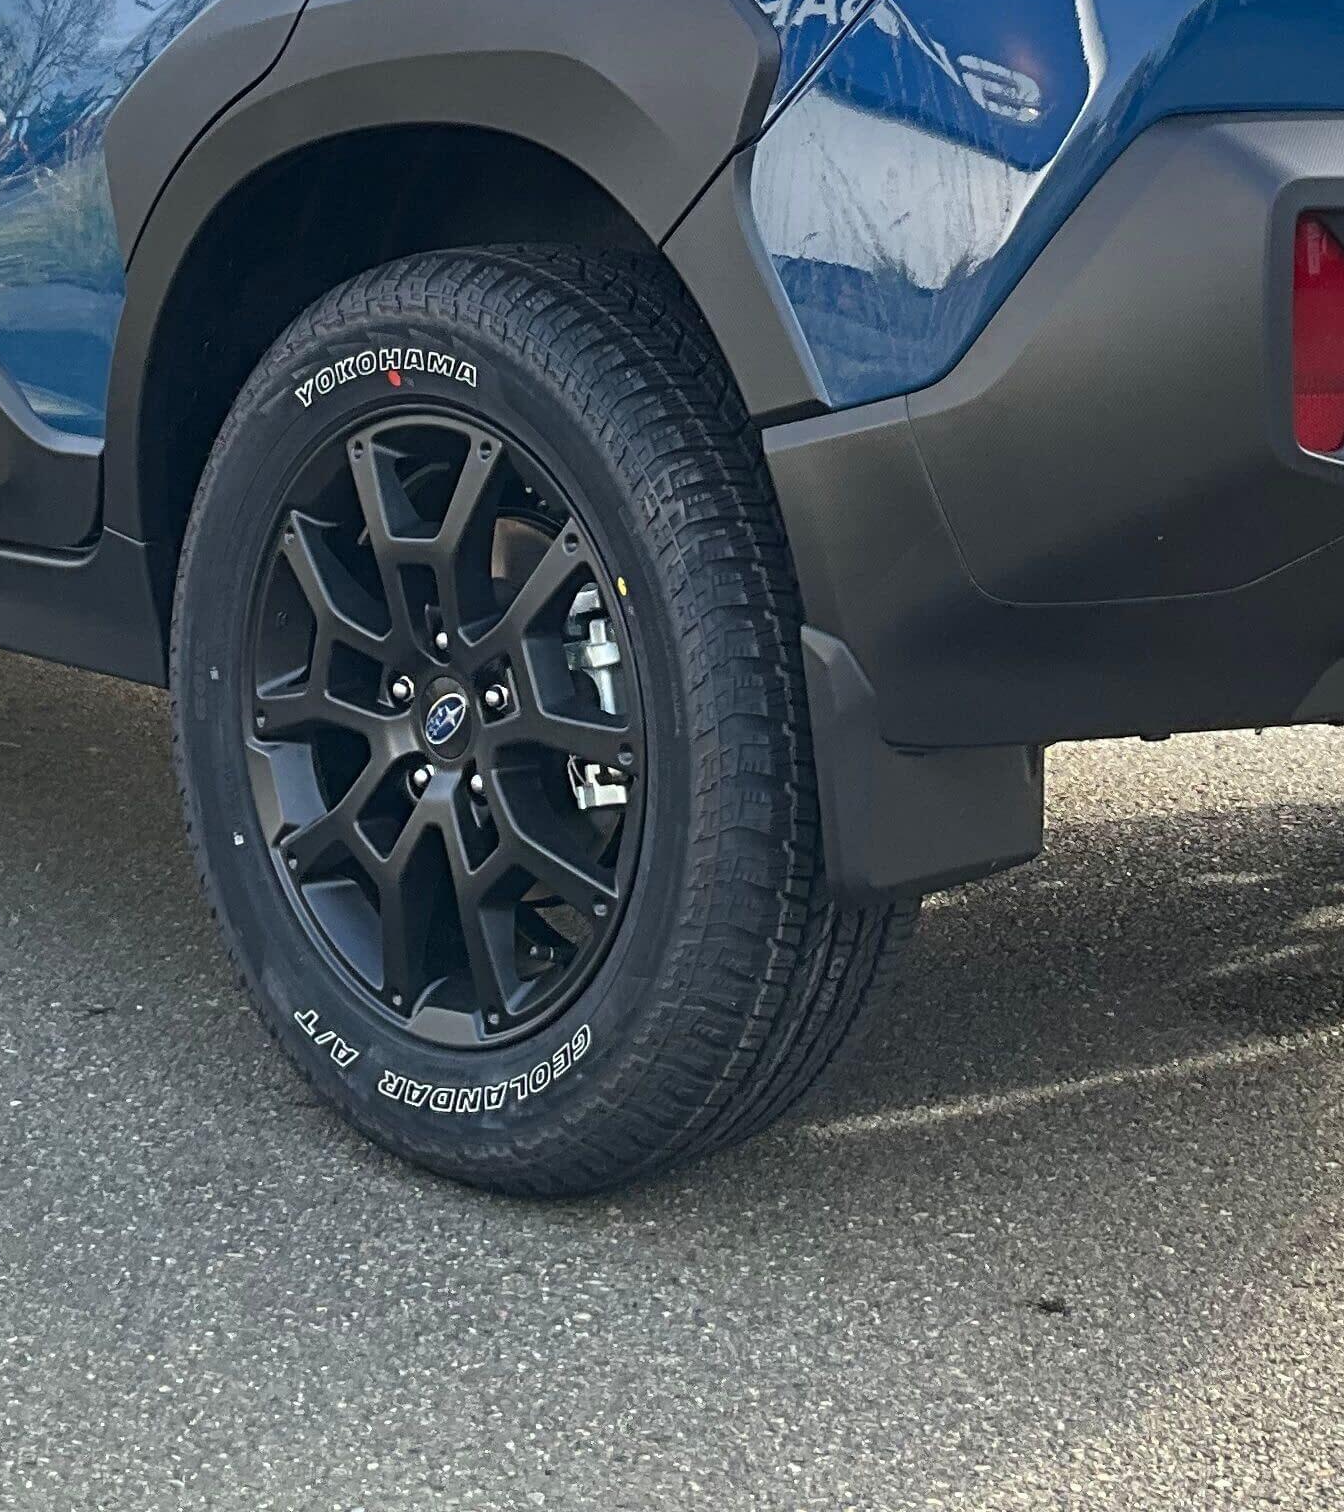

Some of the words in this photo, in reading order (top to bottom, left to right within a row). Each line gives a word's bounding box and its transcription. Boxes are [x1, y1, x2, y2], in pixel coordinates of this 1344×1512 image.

[295, 348, 477, 408] YOKOHAMA
[294, 1009, 360, 1068] A/T
[378, 1024, 591, 1113] GEOLANDAR
